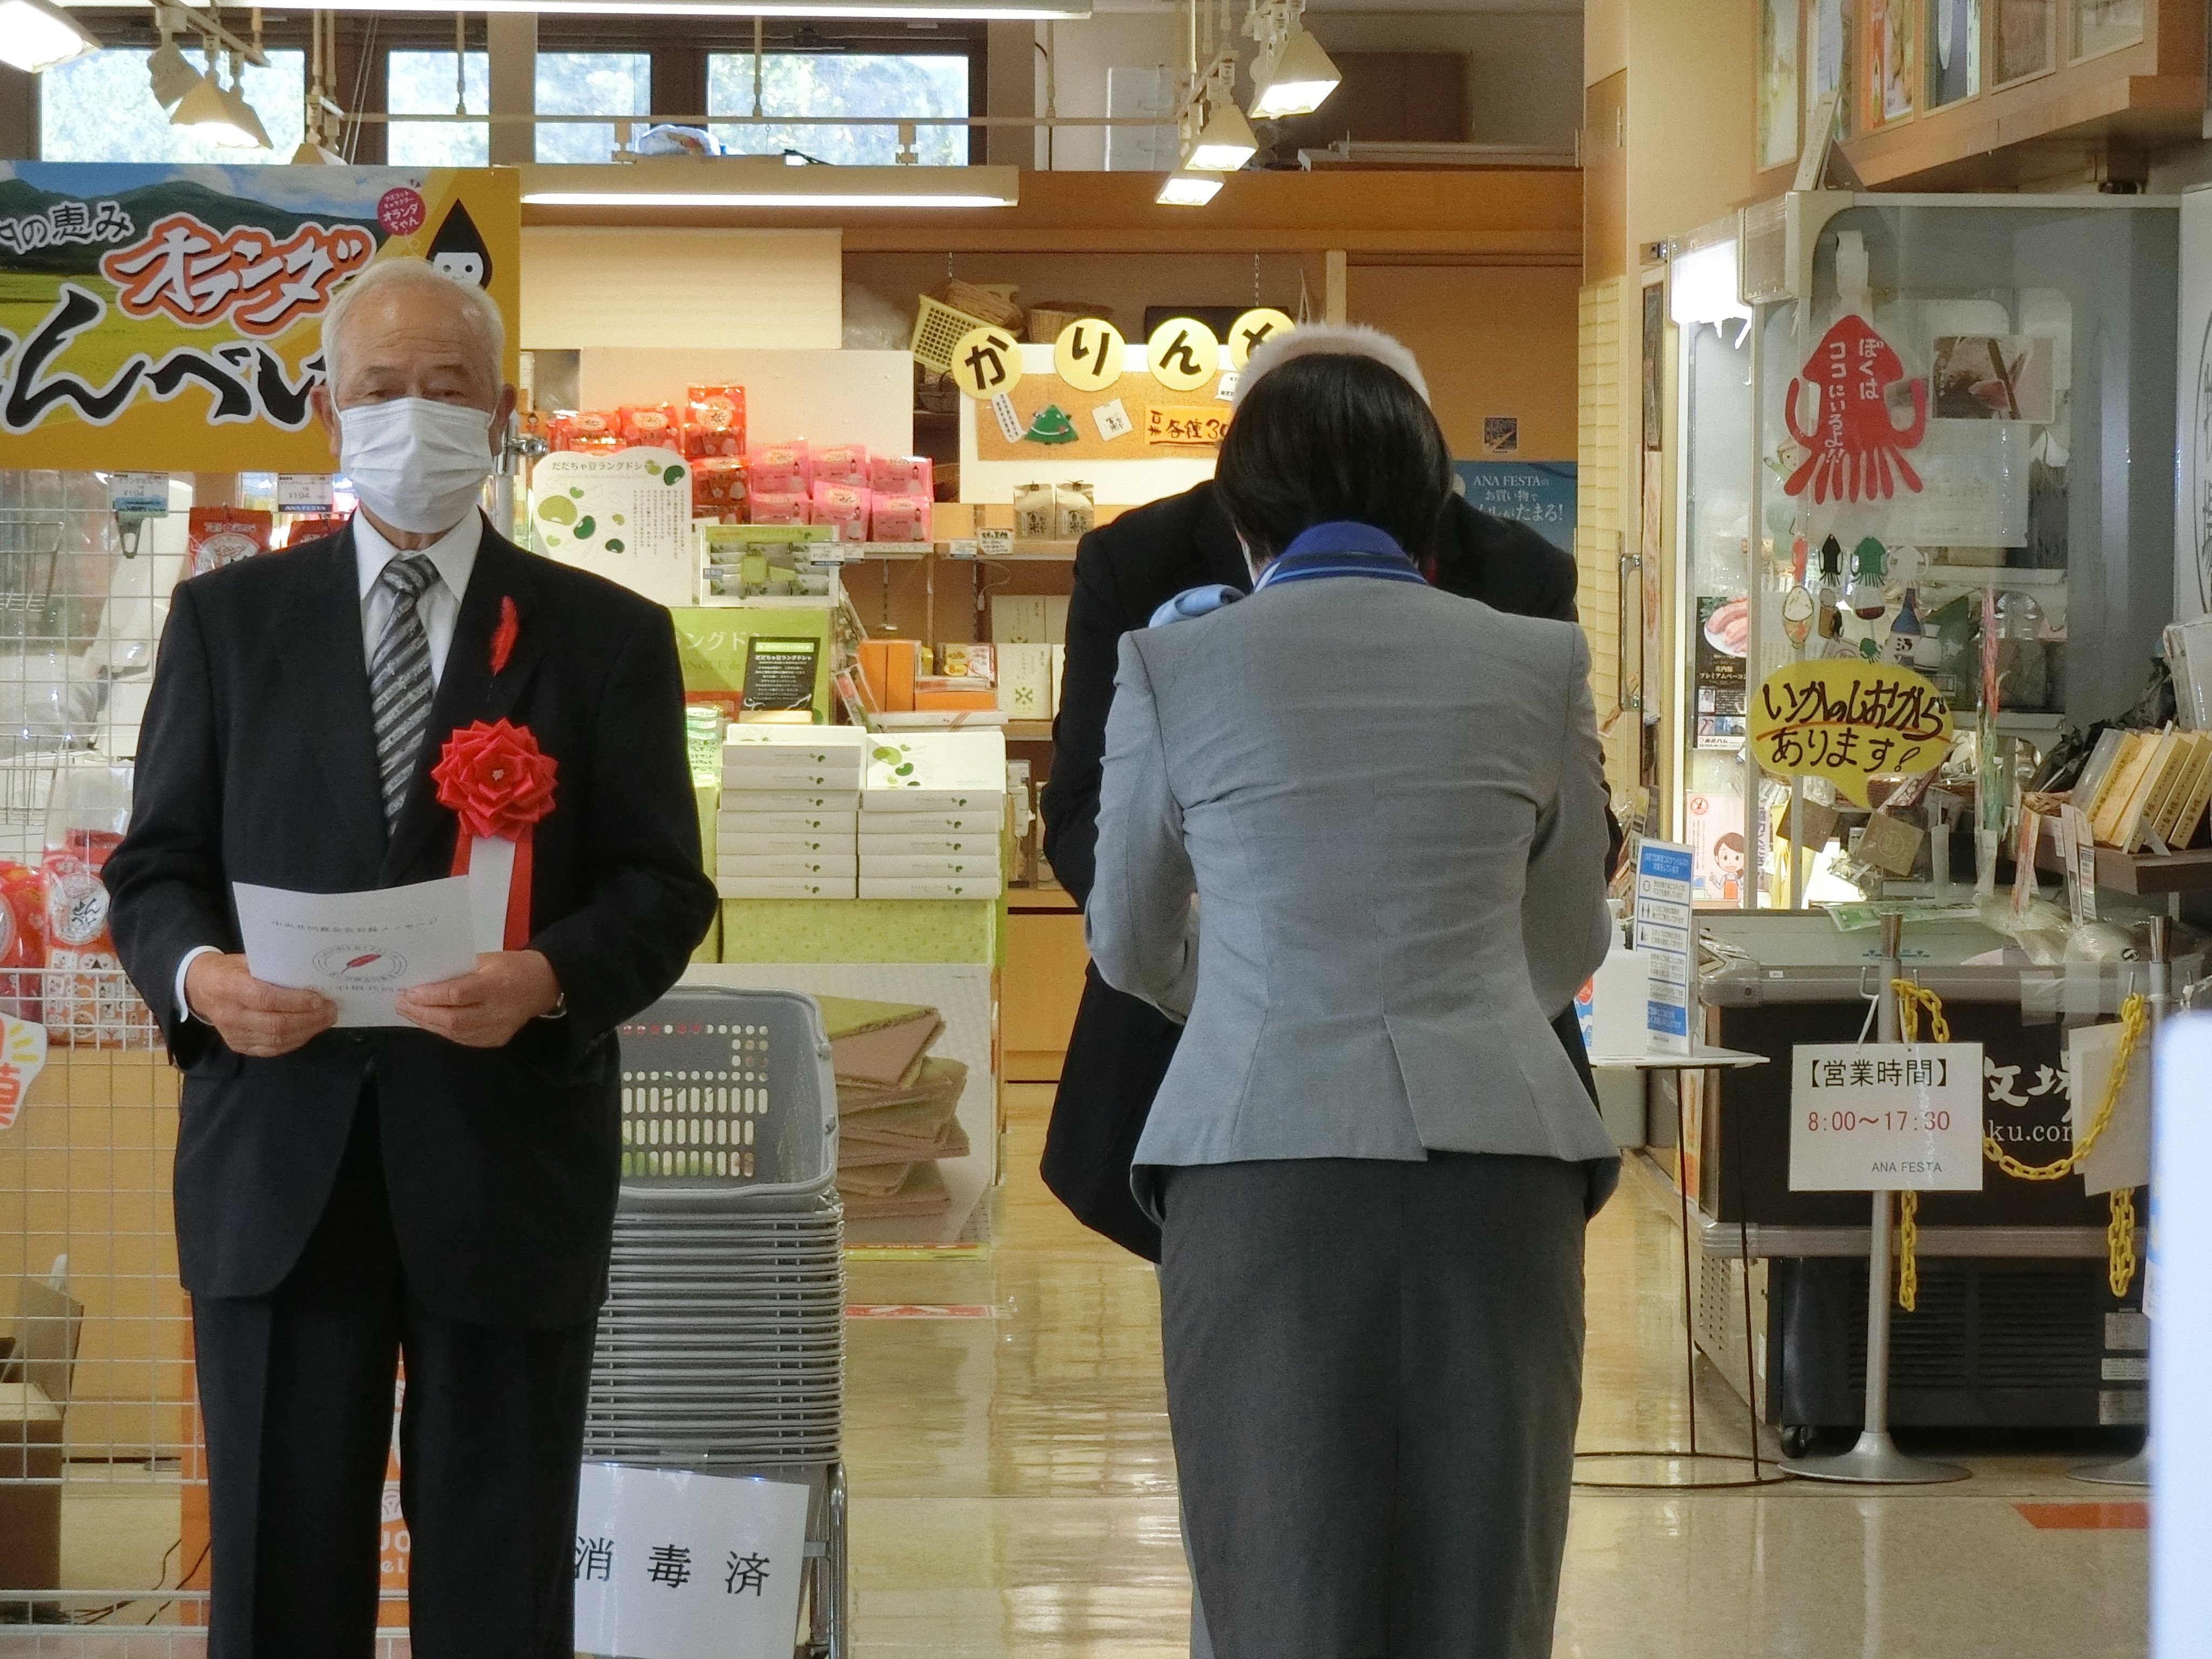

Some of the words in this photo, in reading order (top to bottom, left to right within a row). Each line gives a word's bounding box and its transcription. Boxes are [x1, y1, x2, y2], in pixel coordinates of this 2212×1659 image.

[383, 203, 419, 222] オランダ
[390, 216, 420, 231] ちゃん
[109, 222, 369, 329] オランダ
[1859, 338, 1884, 400] ぼくは
[1473, 475, 1500, 486] ANA
[1810, 1058, 1948, 1088] 【営業時間】
[1871, 1161, 1897, 1173] ANA
[1900, 1161, 1943, 1173] FESTA
[575, 1536, 771, 1597] 消毒済
